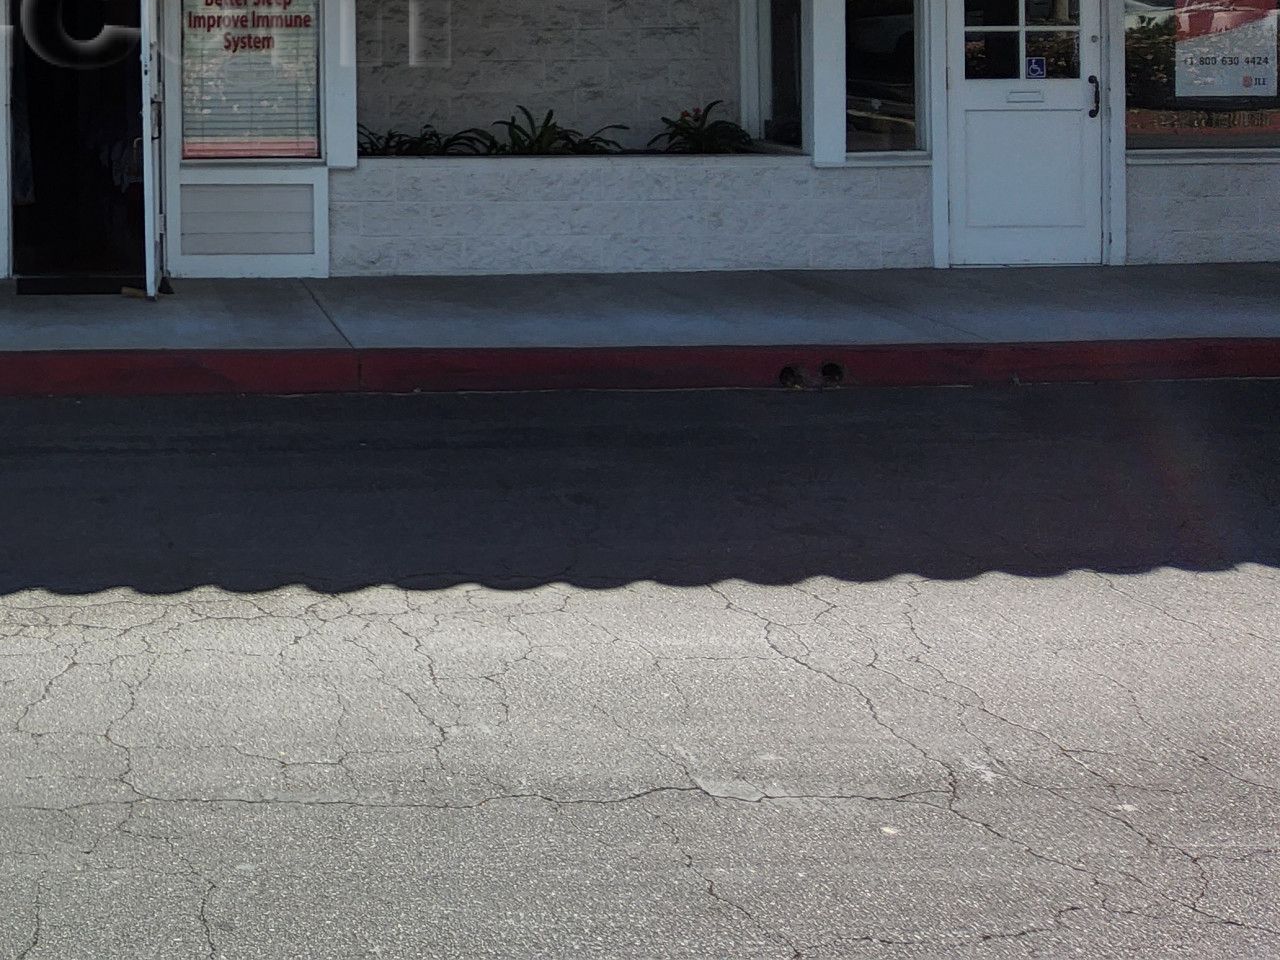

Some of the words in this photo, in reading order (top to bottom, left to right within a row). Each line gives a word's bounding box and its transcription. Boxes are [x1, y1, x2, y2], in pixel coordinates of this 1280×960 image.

[188, 11, 249, 32] Improve
[252, 11, 311, 28] Immune
[224, 33, 275, 53] System
[1199, 56, 1217, 66] 800
[1221, 56, 1240, 66] 630
[1244, 56, 1270, 66] 4424
